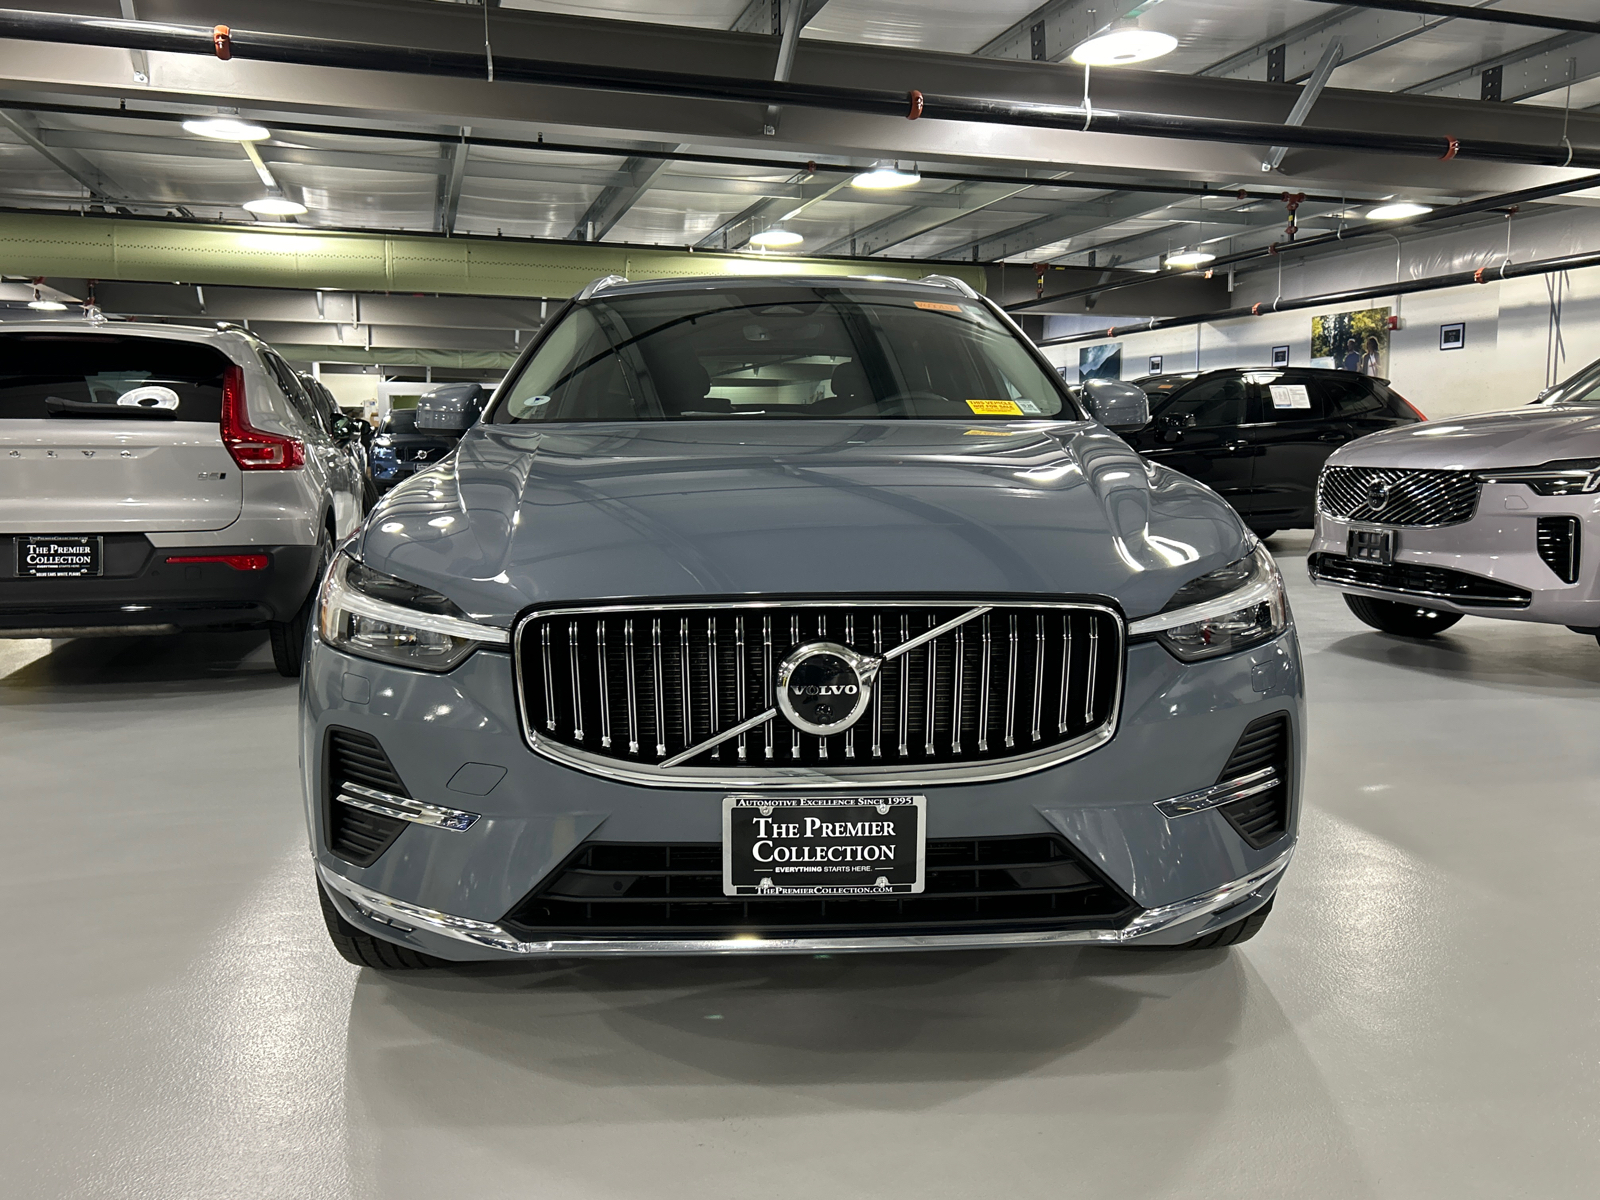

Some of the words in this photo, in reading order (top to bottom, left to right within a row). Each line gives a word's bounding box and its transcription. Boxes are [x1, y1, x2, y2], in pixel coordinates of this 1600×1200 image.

[26, 544, 49, 554] THE
[50, 544, 91, 554] PREMIER
[26, 553, 91, 564] COLLECTION
[790, 684, 858, 696] VOLVO
[738, 799, 798, 807] AUTOMOTIVE
[800, 798, 856, 806] EXCELLENCE
[858, 797, 885, 805] SINCE
[887, 797, 912, 805] 1995
[752, 817, 800, 838] THE
[803, 816, 896, 838] PREMIER
[752, 839, 896, 863] COLLECTION
[754, 886, 894, 895] THEPREMIERCOLLECTION.COM
